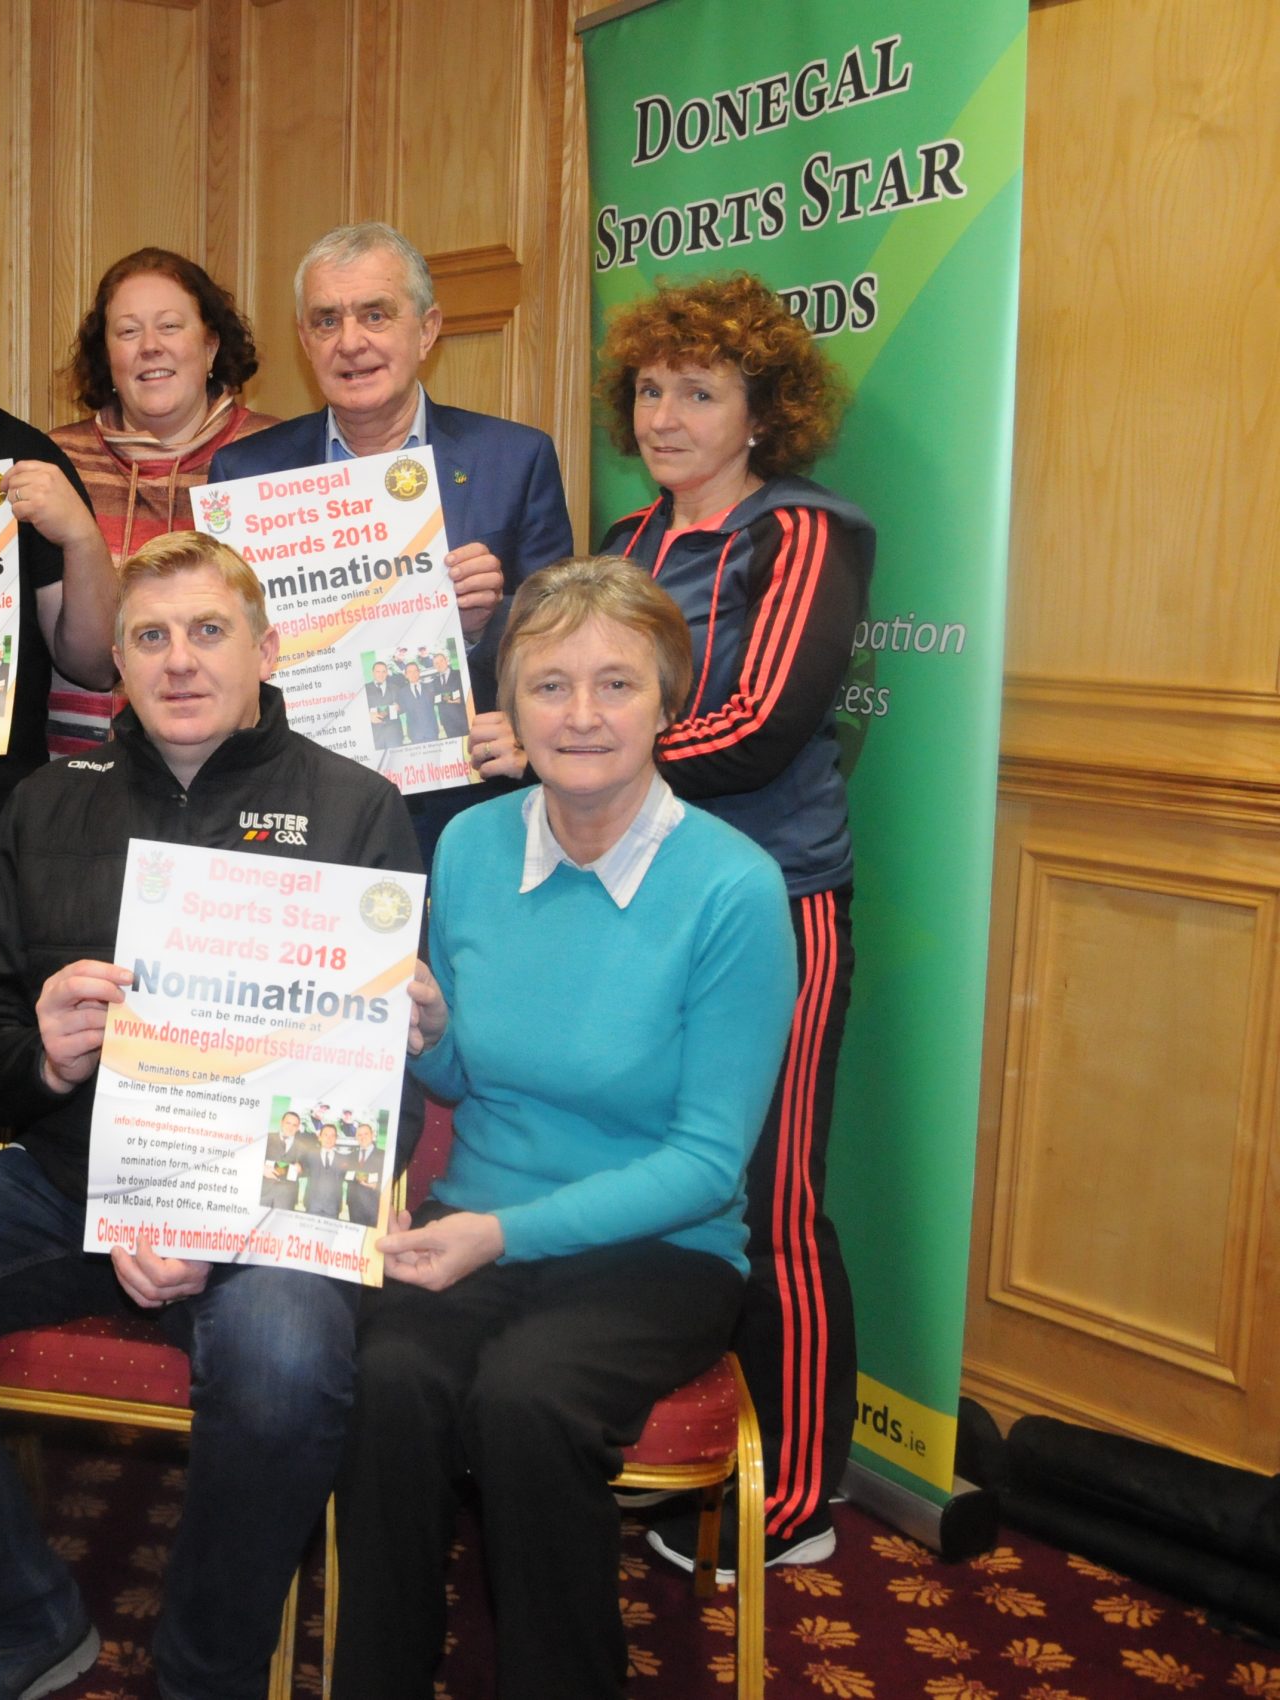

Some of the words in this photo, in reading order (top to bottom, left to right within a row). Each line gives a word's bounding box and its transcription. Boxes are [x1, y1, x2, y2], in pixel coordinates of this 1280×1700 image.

[256, 466, 350, 500] Donegal
[243, 506, 320, 535] Sports
[325, 497, 374, 520] Star
[240, 534, 326, 565] Awards
[331, 521, 389, 549] 2018
[259, 550, 433, 601] minations
[275, 600, 294, 612] can
[296, 598, 309, 609] be
[311, 593, 339, 606] made
[340, 588, 372, 601] online
[373, 585, 383, 595] at
[403, 762, 426, 785] 23rd
[426, 756, 473, 782] November
[239, 811, 308, 832] ULSTER
[207, 856, 322, 896] Donegal
[181, 890, 273, 923] Sports
[281, 903, 340, 933] Star
[164, 926, 269, 962] Awards
[278, 939, 347, 971] 2018
[130, 957, 390, 1024] Nominations
[190, 1006, 212, 1019] can
[215, 1009, 230, 1021] be
[233, 1013, 266, 1026] made
[269, 1017, 305, 1031] online
[309, 1022, 322, 1033] at
[113, 1019, 395, 1069] www.donegalsportsstarawards.ie
[137, 1061, 190, 1078] Nominations
[192, 1069, 208, 1080] can
[210, 1071, 220, 1082] be
[222, 1074, 246, 1085] made
[148, 1082, 167, 1094] from
[169, 1086, 183, 1096] the
[185, 1090, 237, 1104] nominations
[238, 1096, 260, 1109] page
[154, 1104, 170, 1113] and
[172, 1107, 206, 1118] emailed
[208, 1110, 217, 1120] to
[126, 1135, 135, 1145] or
[137, 1135, 147, 1148] by
[150, 1139, 197, 1154] completing
[207, 1146, 235, 1158] simple
[120, 1155, 166, 1169] nomination
[193, 1162, 220, 1174] which
[221, 1165, 238, 1176] can
[116, 1173, 126, 1185] be
[128, 1172, 177, 1190] downloaded
[179, 1179, 195, 1190] and
[197, 1182, 227, 1192] posted
[229, 1185, 239, 1194] to
[155, 1196, 174, 1208] Post
[96, 1216, 136, 1250] Closing
[161, 1221, 177, 1248] for
[247, 1228, 284, 1262] Friday
[285, 1234, 312, 1261] 23rd
[313, 1241, 370, 1274] November
